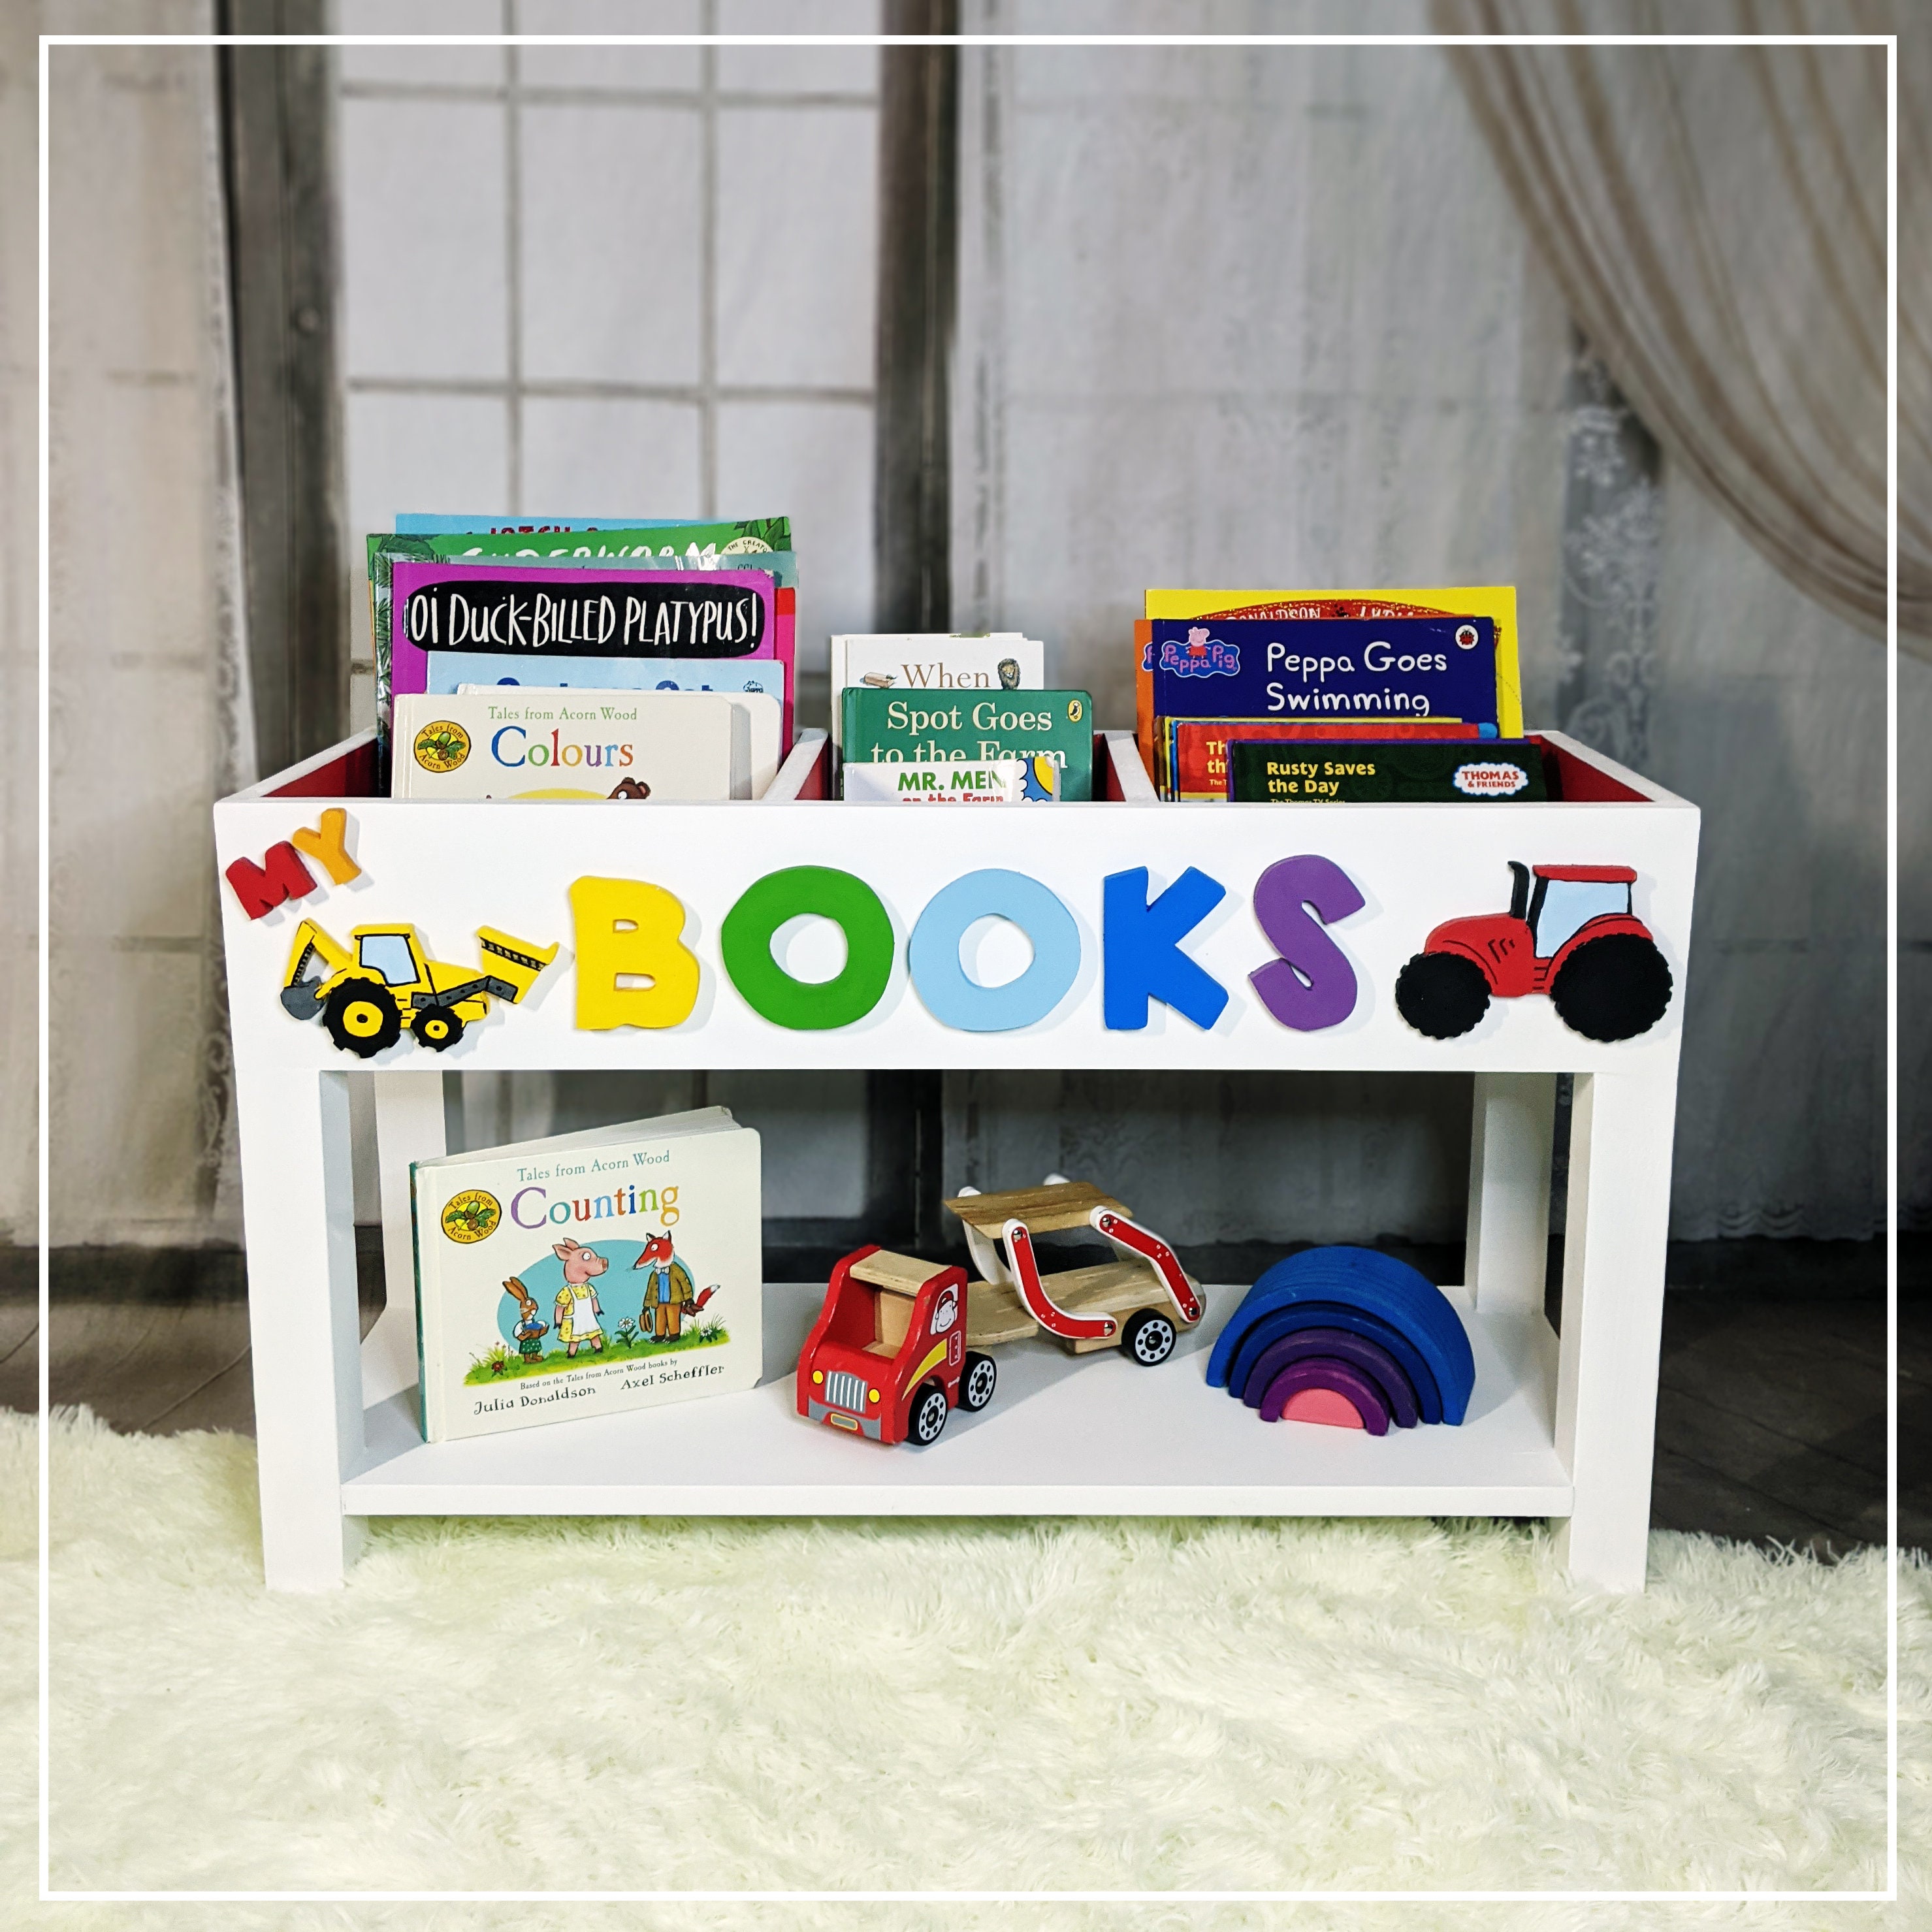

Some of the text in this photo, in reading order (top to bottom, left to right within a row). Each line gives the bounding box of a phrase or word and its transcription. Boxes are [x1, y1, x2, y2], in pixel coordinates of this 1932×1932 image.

[743, 539, 769, 553] CREATO
[624, 592, 756, 649] PLATYPUS!
[1165, 644, 1211, 673] Peppa
[1212, 645, 1235, 669] Pig
[1267, 641, 1447, 683] Peppa Goes
[901, 662, 991, 688] When
[488, 706, 637, 720] Tales from Acorn Wood
[1266, 682, 1430, 716] Swimming
[421, 724, 463, 739] Tales from
[888, 701, 1053, 735] Spot Goes
[491, 725, 634, 767] Colours
[871, 742, 904, 763] to
[914, 740, 967, 763] the
[898, 771, 1006, 791] MR. MEN
[1267, 762, 1376, 778] Rusty Saves
[1462, 771, 1519, 780] THOMAS
[1268, 779, 1340, 796] the Day
[225, 807, 361, 920] MY
[568, 854, 1366, 1032] BOOKS
[517, 1150, 670, 1182] Tales from Acorn Wood
[448, 1192, 493, 1209] Tales from
[511, 1185, 679, 1229] Counting
[521, 1380, 539, 1390] Based
[553, 1376, 564, 1385] the
[566, 1374, 583, 1383] Tales
[604, 1368, 624, 1377] Acorn
[626, 1363, 646, 1372] Wood
[649, 1360, 668, 1369] books
[620, 1364, 725, 1390] Axel Scheffler
[474, 1387, 596, 1415] Julia Donaldson
